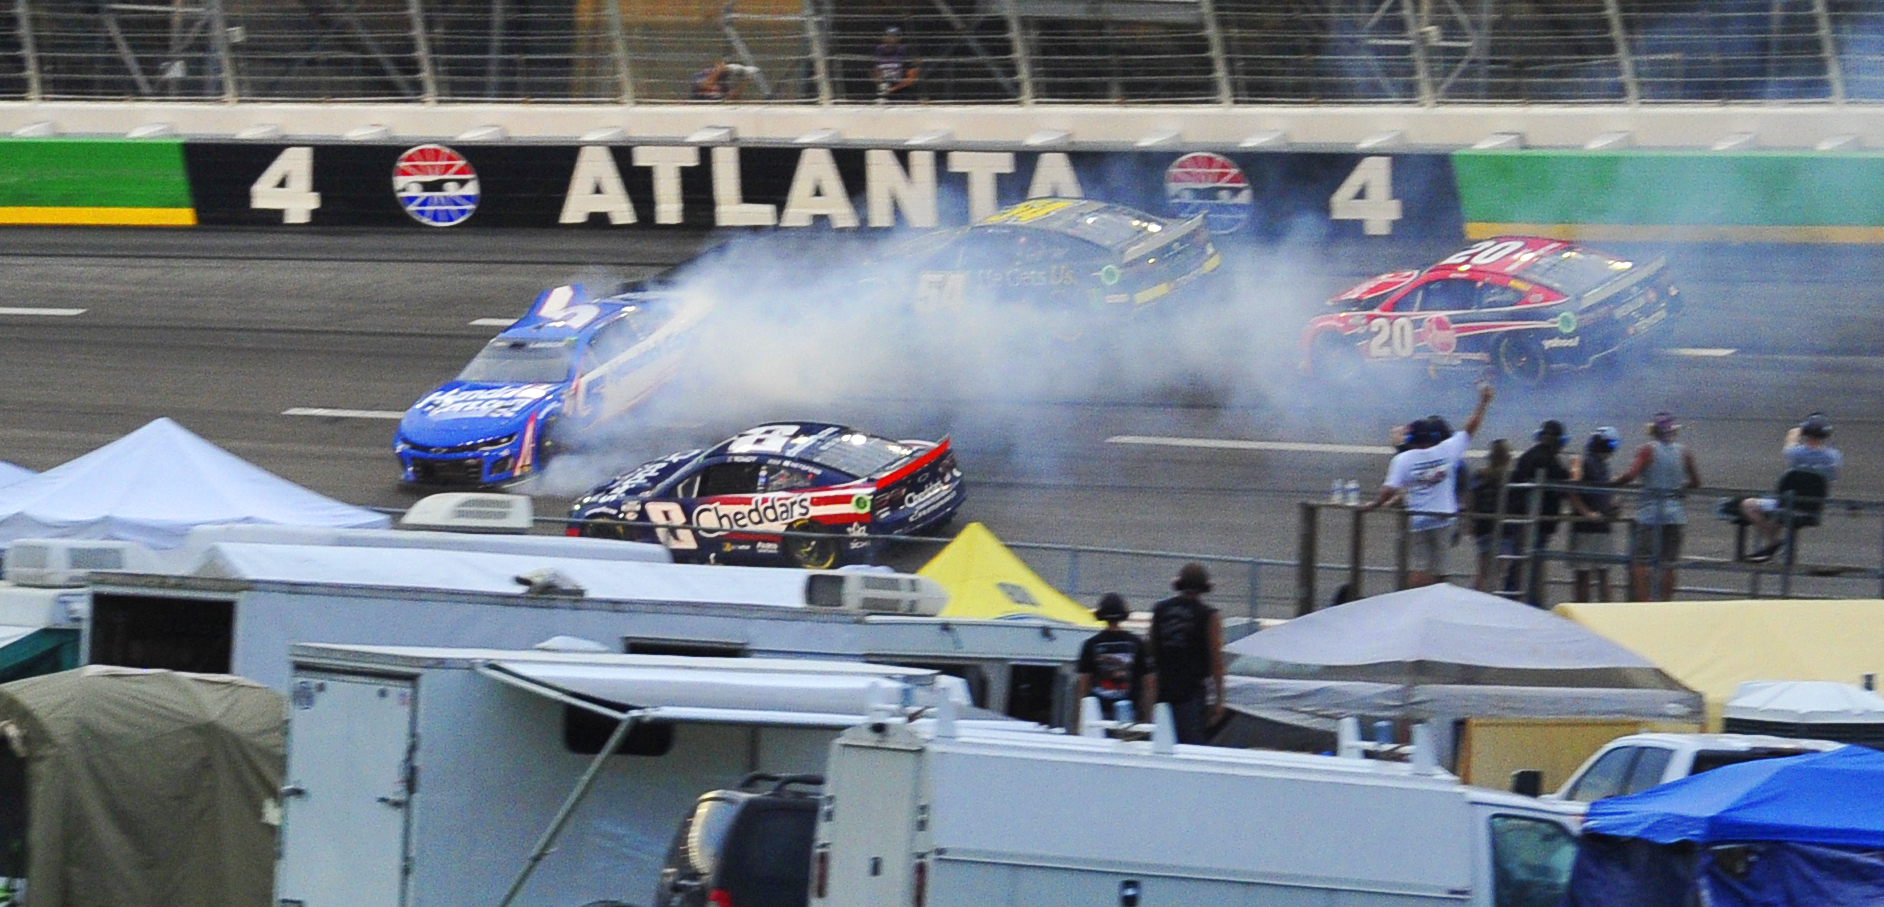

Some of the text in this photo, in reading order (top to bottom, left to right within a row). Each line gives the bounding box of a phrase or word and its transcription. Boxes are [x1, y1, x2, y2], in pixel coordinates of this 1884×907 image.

[250, 146, 321, 224] 4
[558, 145, 1086, 227] ATLANTA
[1329, 156, 1402, 235] 4
[1439, 240, 1525, 264] 20
[538, 283, 601, 331] 5
[1368, 316, 1414, 358] 20
[727, 424, 801, 454] 8
[644, 501, 698, 549] 8
